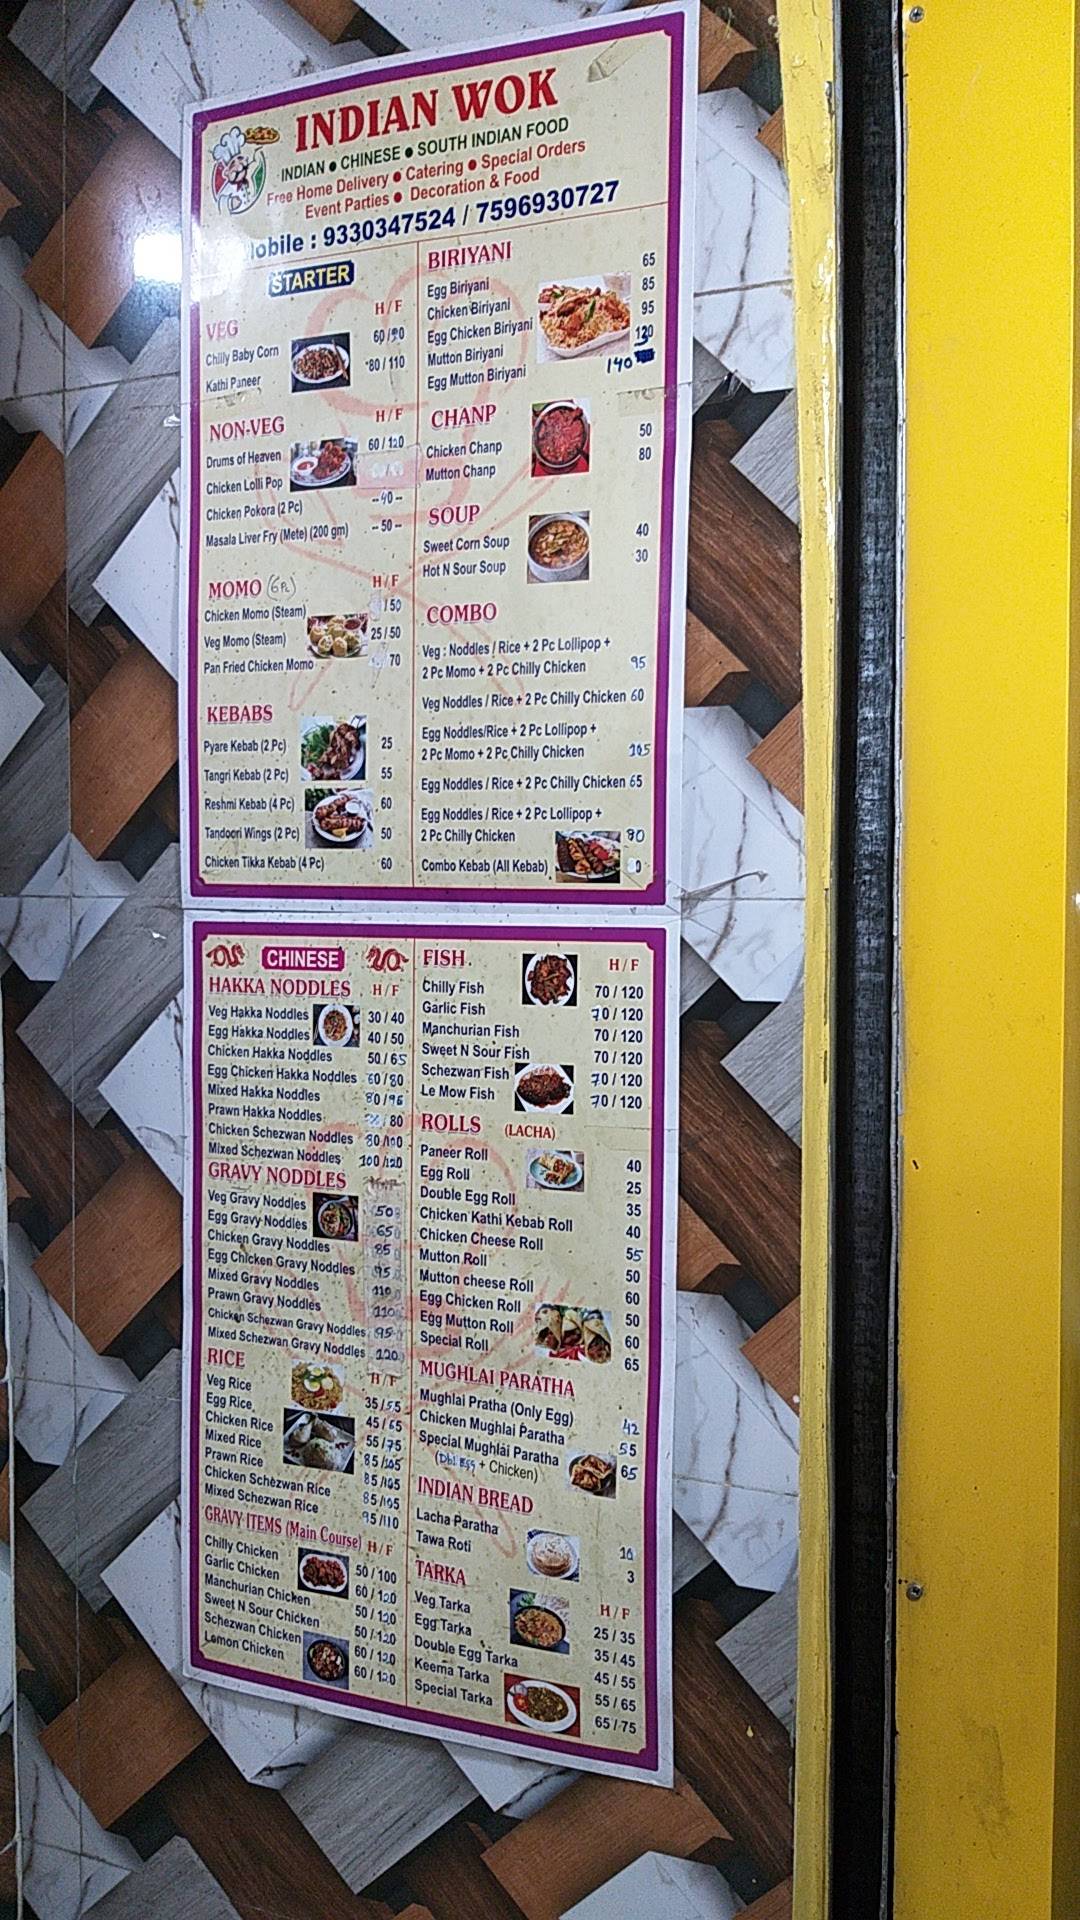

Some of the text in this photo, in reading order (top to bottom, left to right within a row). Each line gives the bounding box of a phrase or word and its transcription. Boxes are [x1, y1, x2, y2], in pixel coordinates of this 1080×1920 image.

[296, 68, 558, 152] INDIAN WOK
[282, 117, 569, 182] INDIAN CHINESE SOUTH INDIAN FOOD
[267, 141, 586, 206] Free Home Delivery Catering Special Orders
[306, 166, 539, 219] Event Parties Decoration & Food
[323, 206, 456, 247] 9330347524
[476, 181, 620, 224] 7596930727
[428, 242, 511, 270] BIRIYANI
[643, 253, 655, 266] 65
[272, 265, 350, 293] STARTER
[642, 277, 655, 290] 85
[428, 278, 489, 299] Egg Biriyani
[642, 302, 654, 314] 95
[207, 320, 238, 339] VEG
[428, 317, 533, 345] Egg Chicken Biriyani
[206, 345, 279, 366] Chilly Baby Corn
[428, 345, 503, 367] Mutton Biriyani
[607, 358, 632, 374] 140
[206, 375, 261, 393] Kathi Paneer
[432, 405, 497, 427] CHANP
[210, 416, 284, 441] NON-VEG
[640, 423, 652, 436] 50
[426, 440, 502, 458] Chicken Chanp
[639, 448, 651, 460] 80
[207, 452, 281, 468] Drums of Heaven
[207, 477, 282, 494] Chicken Lolli Pop
[429, 505, 480, 524] SOUP
[206, 523, 348, 547] Masala Liver Fry (Mete) (200 gm)
[636, 524, 649, 536] 40
[424, 535, 509, 553] Sweet Corn Soup
[636, 550, 647, 562] 30
[208, 579, 262, 598] MOMO
[205, 605, 307, 622] Chicken Momo (Steam)
[427, 603, 496, 624] COMBO
[204, 658, 313, 674] Pan Fried Chicken Momo
[207, 705, 273, 722] KEBABS
[381, 737, 392, 749] 25
[204, 768, 288, 783] Tangri Kebab (2 Pc)
[381, 767, 392, 779] 55
[422, 859, 548, 875] Combo Kebab (All Kebab)
[267, 950, 339, 968] CHINESE
[423, 950, 465, 966] FISH
[209, 977, 351, 996] HAKKA NODDLES
[373, 984, 381, 995] H
[392, 985, 399, 995] F
[423, 980, 484, 995] Chilly Fish
[595, 985, 609, 998] 70
[622, 986, 643, 999] 120
[209, 1005, 309, 1020] Veg Hakka Noddles
[368, 1011, 381, 1023] 30
[391, 1012, 404, 1024] 40
[208, 1045, 332, 1062] Chicken Hakka Noddles
[422, 1114, 481, 1133] ROLLS
[505, 1124, 556, 1140] (LACHA)
[208, 1143, 341, 1164] Mixed Schezwan Noddles
[421, 1145, 488, 1161] Paneer Roll
[420, 1166, 470, 1181] Egg Roll
[626, 1160, 641, 1172] 40
[208, 1163, 346, 1188] GRAVY NODDLES
[627, 1182, 641, 1194] 25
[207, 1348, 245, 1368] RICE
[207, 1374, 251, 1391] Veg Rice
[420, 1360, 575, 1396] MUGHLAI PARATHA
[206, 1411, 273, 1431] Chicken Rice
[205, 1429, 261, 1448] Mixed Rice
[418, 1476, 533, 1514] INDIAN BREAD
[205, 1505, 362, 1549] GRAVY ITEMS (Main Course)
[417, 1508, 499, 1535] Lacha Paratha
[205, 1535, 278, 1559] Chilly Chicken
[356, 1565, 368, 1578] 50
[378, 1570, 396, 1584] 100
[415, 1559, 466, 1586] TARKA
[205, 1630, 284, 1660] Lemon Chicken
[594, 1627, 608, 1640] 25
[620, 1632, 635, 1645] 35
[415, 1679, 492, 1707] Special Tarka
